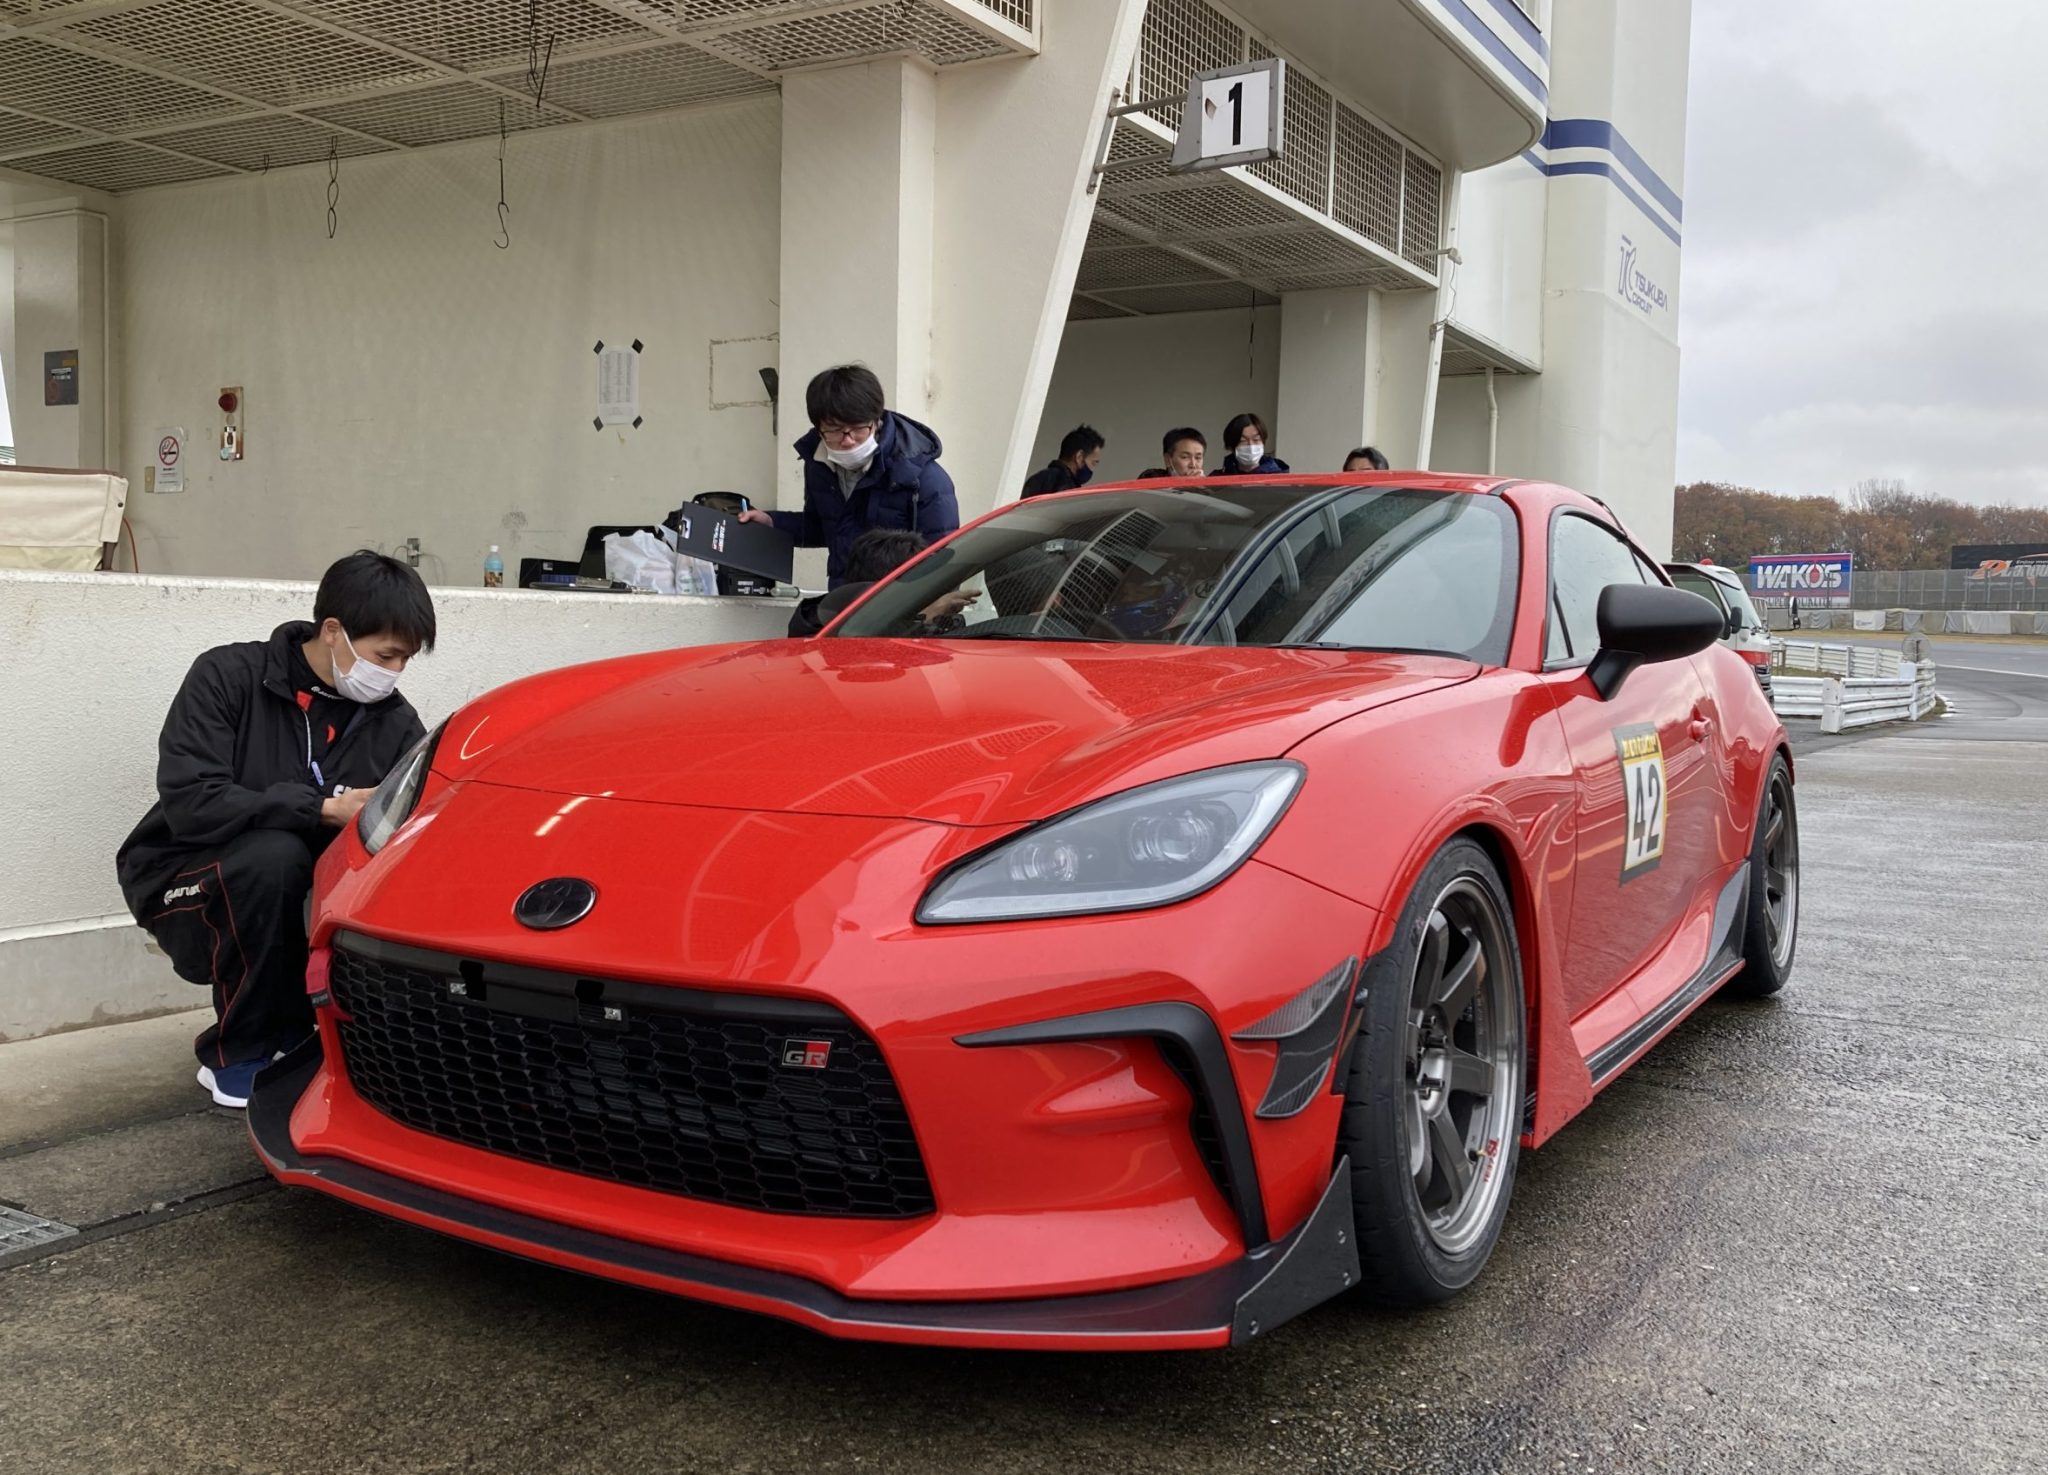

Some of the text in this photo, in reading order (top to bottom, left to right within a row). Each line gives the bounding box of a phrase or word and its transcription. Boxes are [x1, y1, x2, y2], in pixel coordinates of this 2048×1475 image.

[1229, 82, 1243, 146] 1
[1632, 292, 1653, 316] CIRCUIT
[1635, 270, 1667, 312] TSUKUBA
[1757, 563, 1842, 589] WAKO'S
[1633, 764, 1660, 857] 42
[785, 1050, 827, 1067] GR
